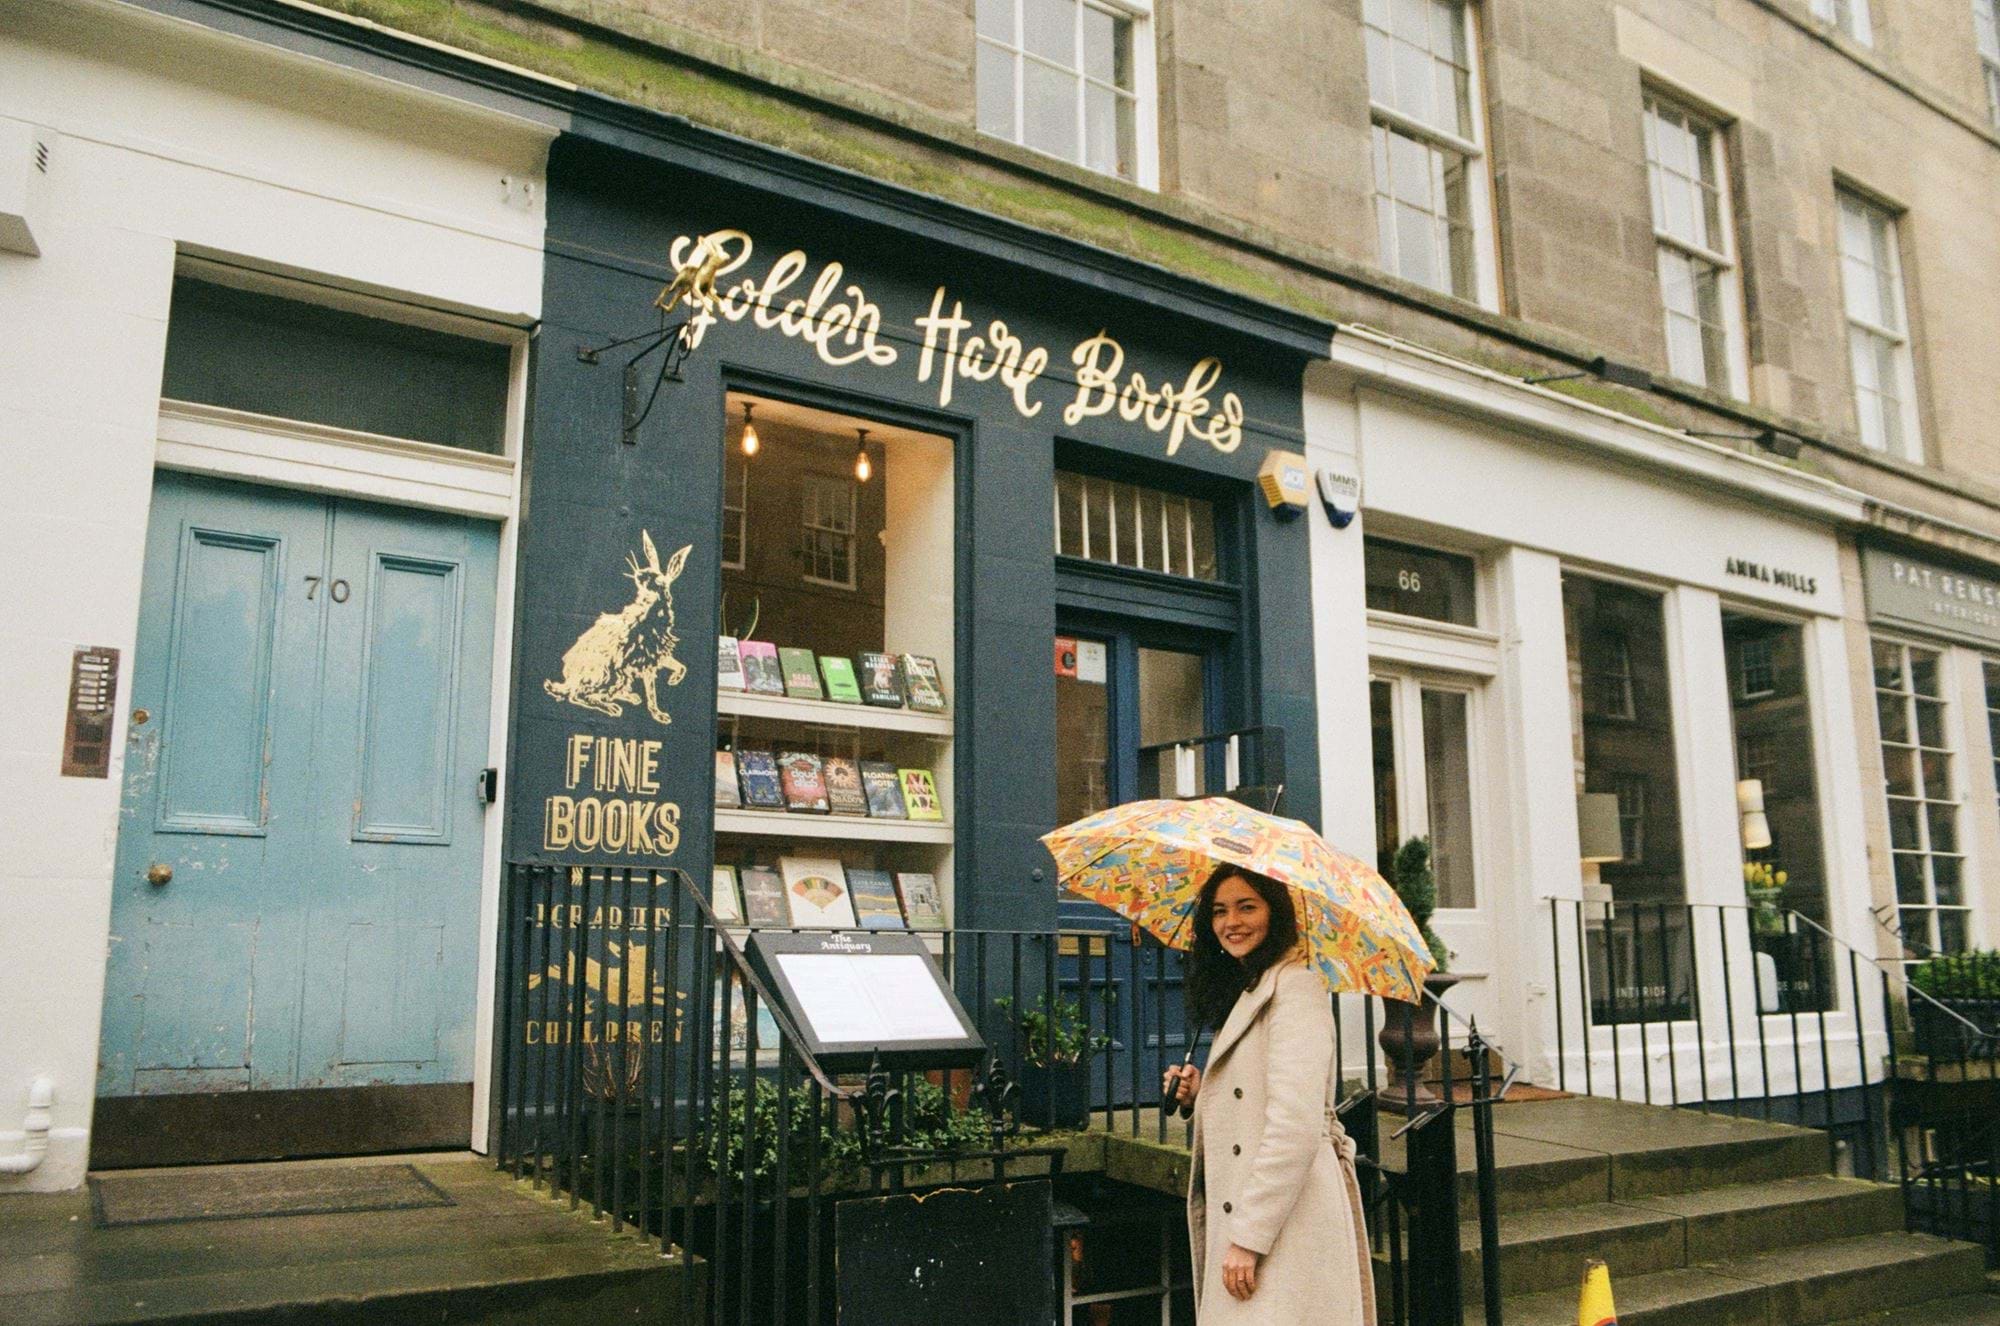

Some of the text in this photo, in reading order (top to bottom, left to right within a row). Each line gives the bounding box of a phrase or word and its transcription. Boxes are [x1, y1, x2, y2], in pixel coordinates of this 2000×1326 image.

[671, 228, 1245, 457] Golden Hare Books
[1398, 569, 1421, 592] 66
[1726, 556, 1818, 595] ANNA MILLS
[1892, 561, 1933, 589] PAT
[304, 576, 350, 604] 70
[566, 734, 663, 795] FINE
[544, 796, 681, 856] BOOKS
[821, 941, 872, 953] Antiquary
[831, 934, 852, 943] The
[526, 1020, 685, 1045] CHILDREN
